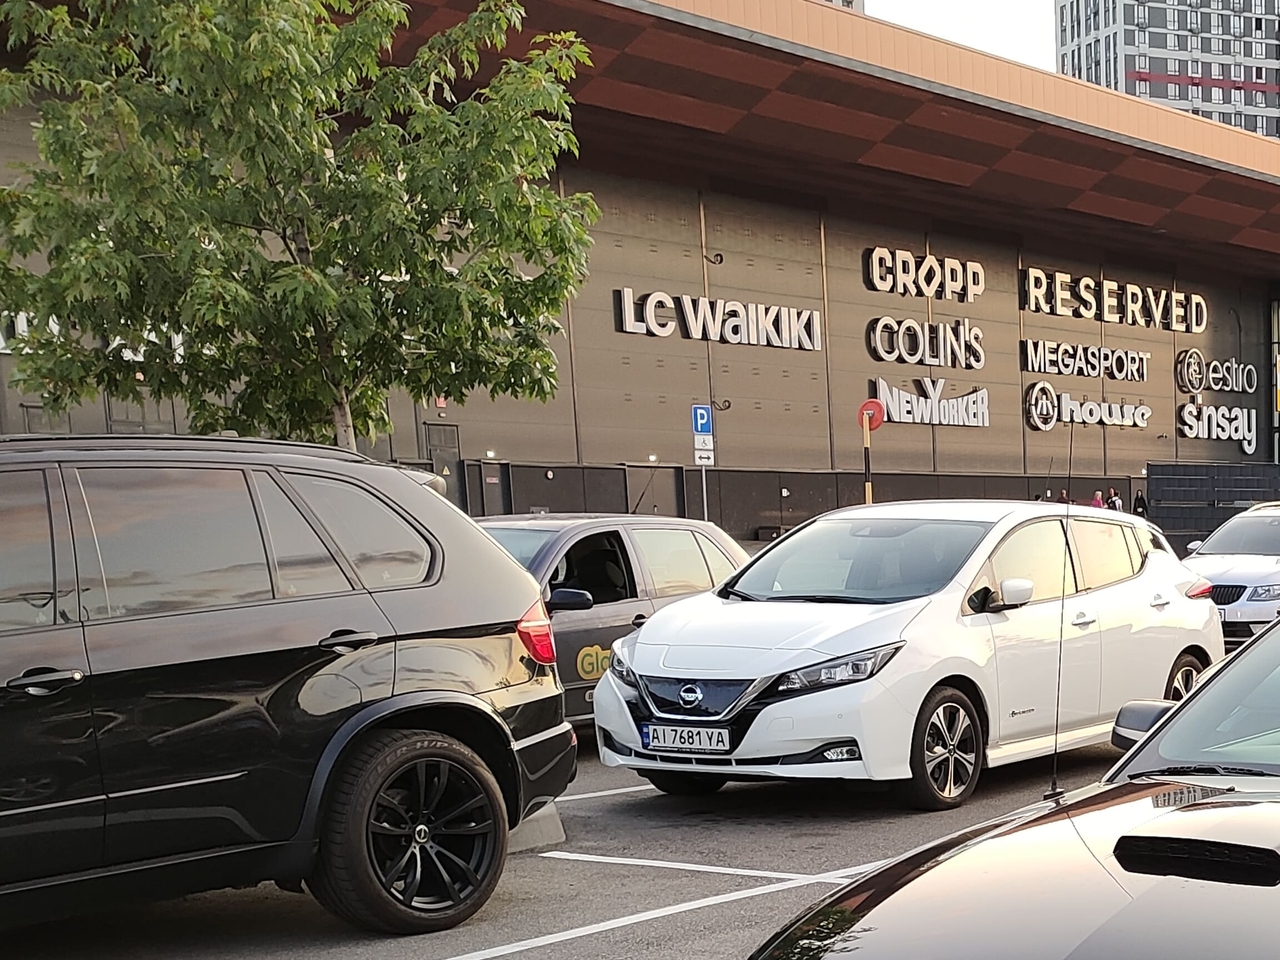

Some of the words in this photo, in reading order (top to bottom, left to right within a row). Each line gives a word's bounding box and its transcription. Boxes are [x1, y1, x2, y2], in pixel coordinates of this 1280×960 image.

[871, 246, 986, 303] CROPP
[622, 286, 677, 337] LC
[1027, 266, 1209, 334] RESERVED
[875, 315, 986, 370] COLIN'S
[1026, 338, 1152, 382] MEGASPORT
[1208, 356, 1258, 394] estro
[696, 408, 708, 432] P
[1059, 392, 1153, 428] house
[1182, 394, 1257, 455] sinsay
[651, 728, 666, 744] AI
[670, 729, 702, 746] 7681
[705, 730, 726, 748] YA
